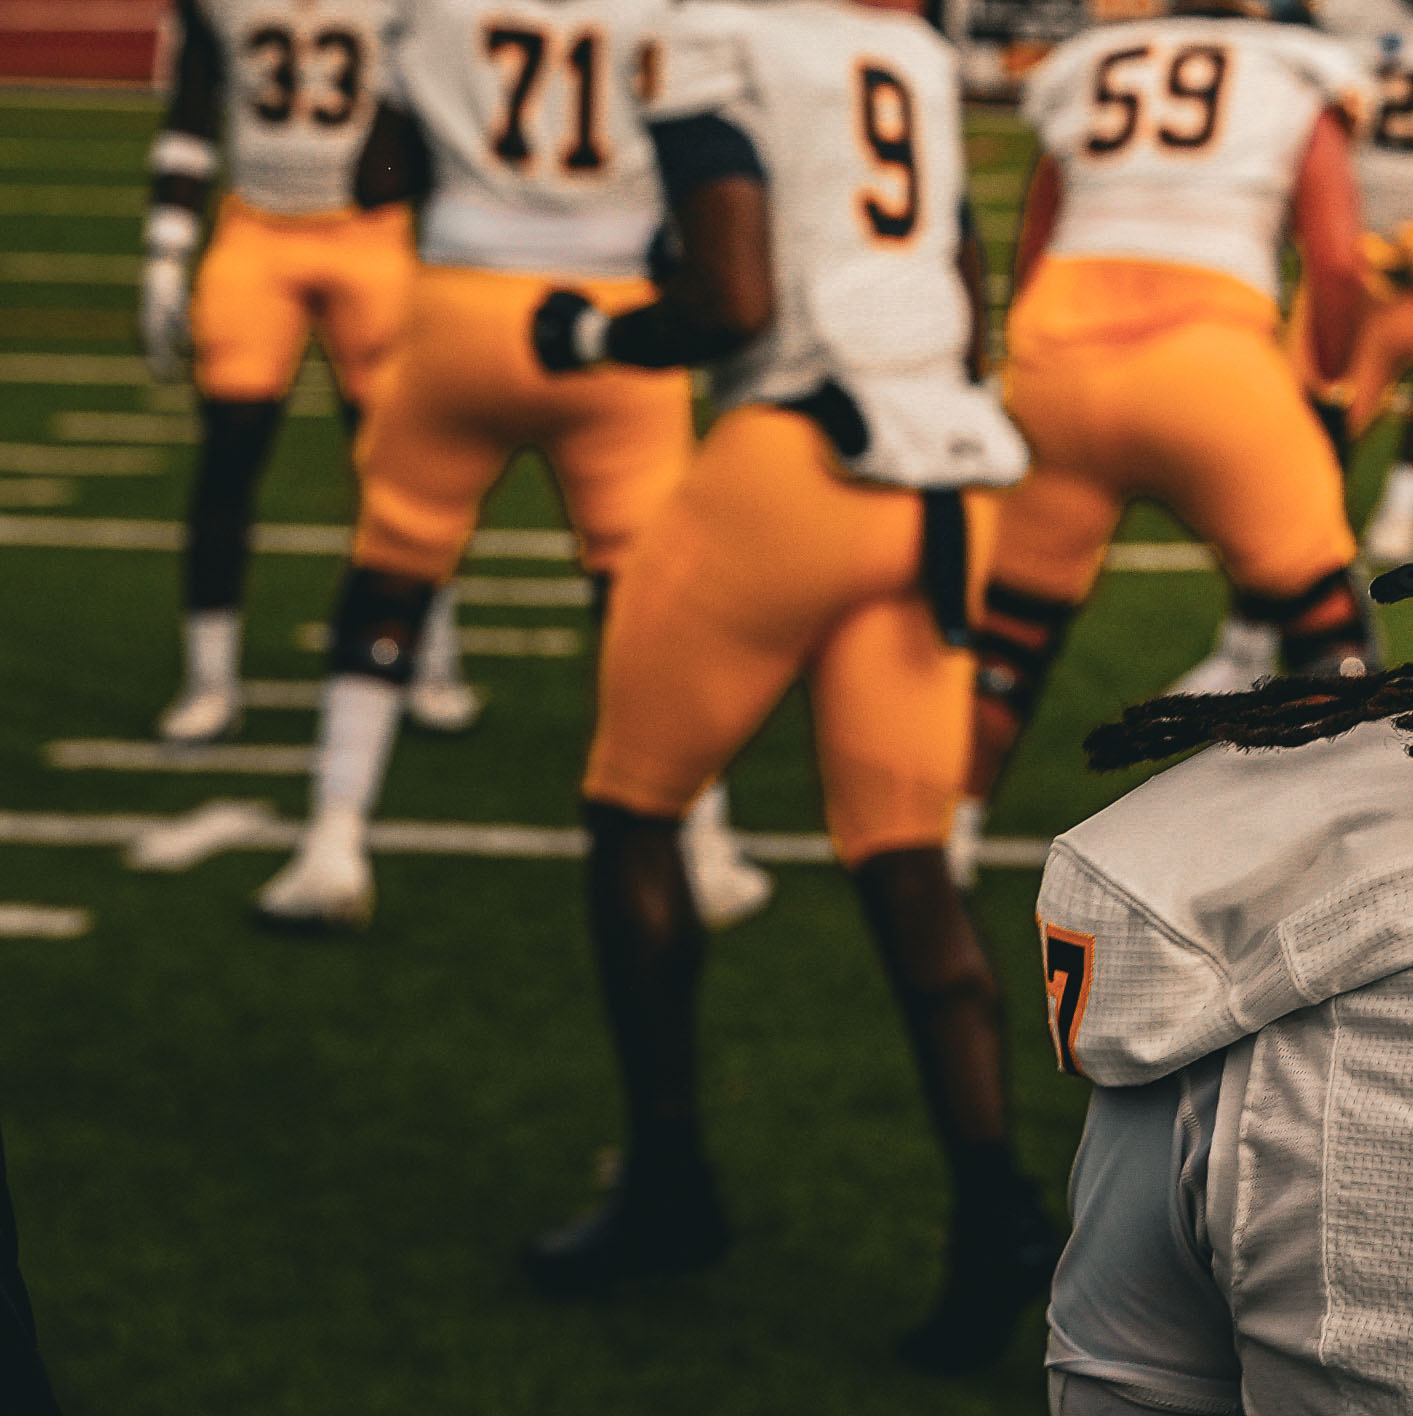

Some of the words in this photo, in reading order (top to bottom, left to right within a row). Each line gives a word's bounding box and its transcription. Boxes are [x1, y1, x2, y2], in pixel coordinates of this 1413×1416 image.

[246, 20, 362, 125] 33
[480, 14, 608, 176] 71
[1084, 40, 1228, 160] 59
[855, 56, 924, 246] 9
